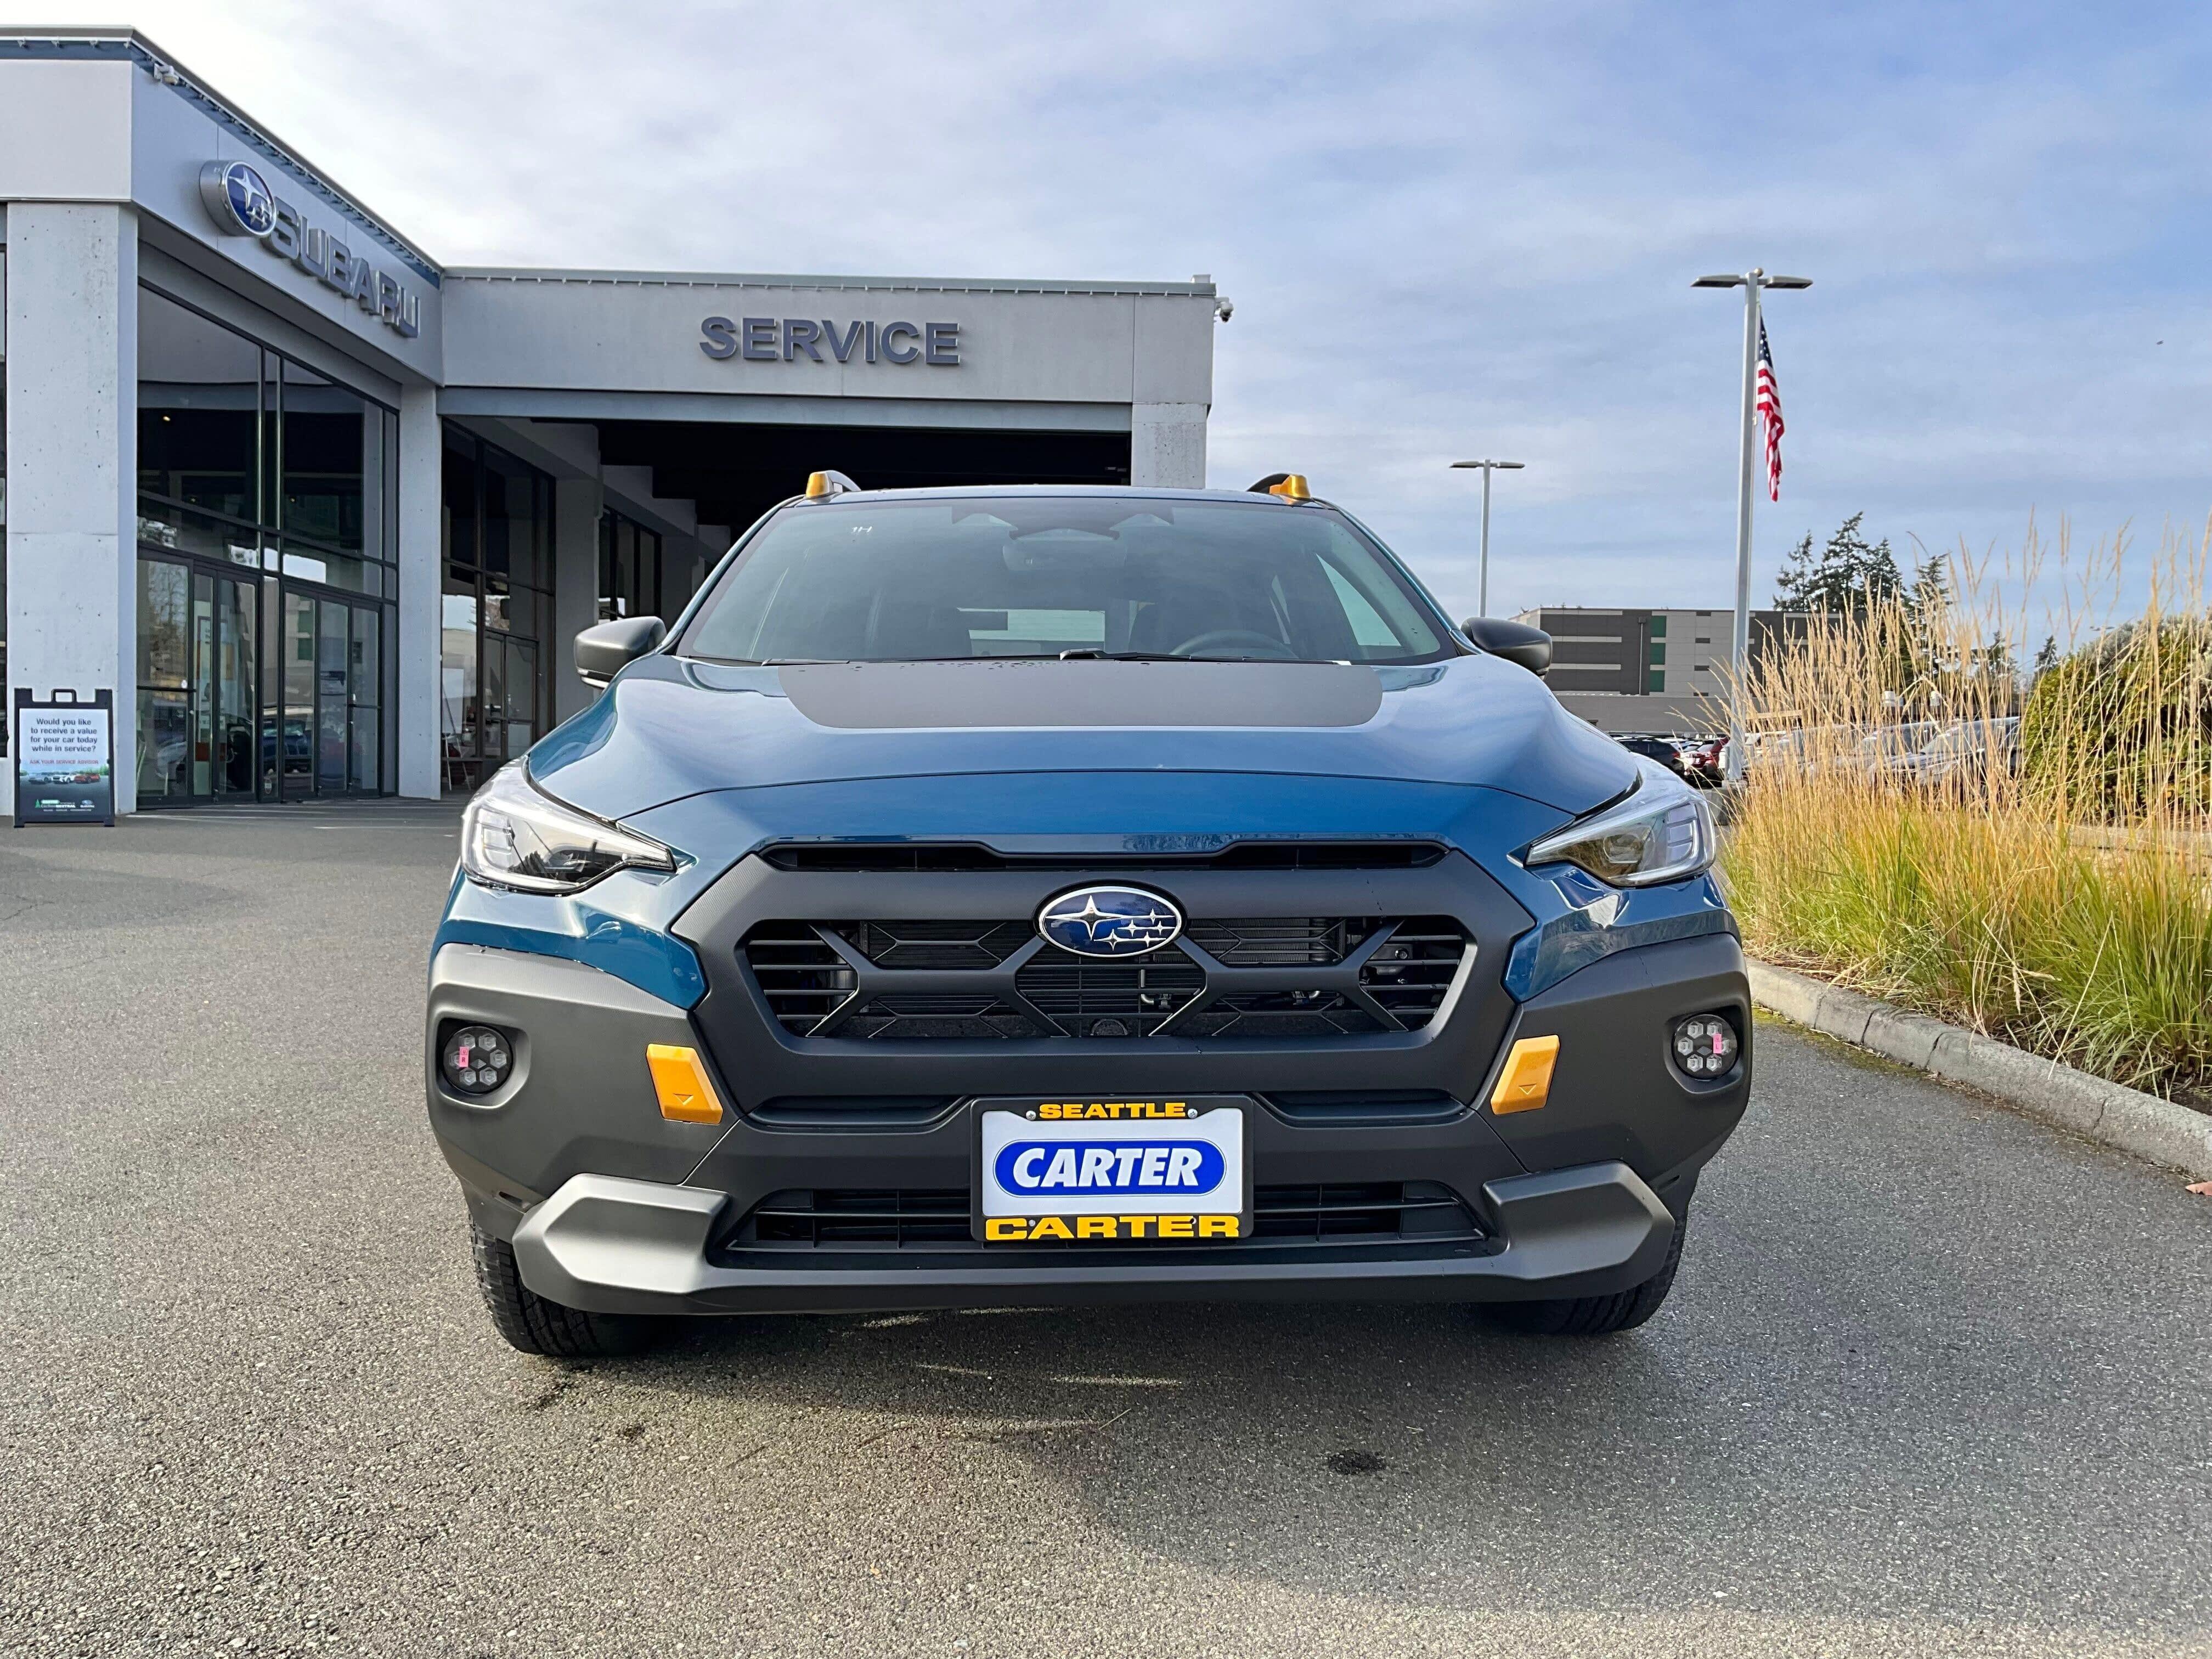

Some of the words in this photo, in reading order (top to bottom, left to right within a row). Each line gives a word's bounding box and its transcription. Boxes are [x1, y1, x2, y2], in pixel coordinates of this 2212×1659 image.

[268, 196, 420, 338] SUBARU
[699, 317, 961, 365] SERVICE
[1039, 1102, 1186, 1119] SEATTLE
[1012, 1147, 1203, 1188] CARTER
[985, 1215, 1239, 1241] CARTER
